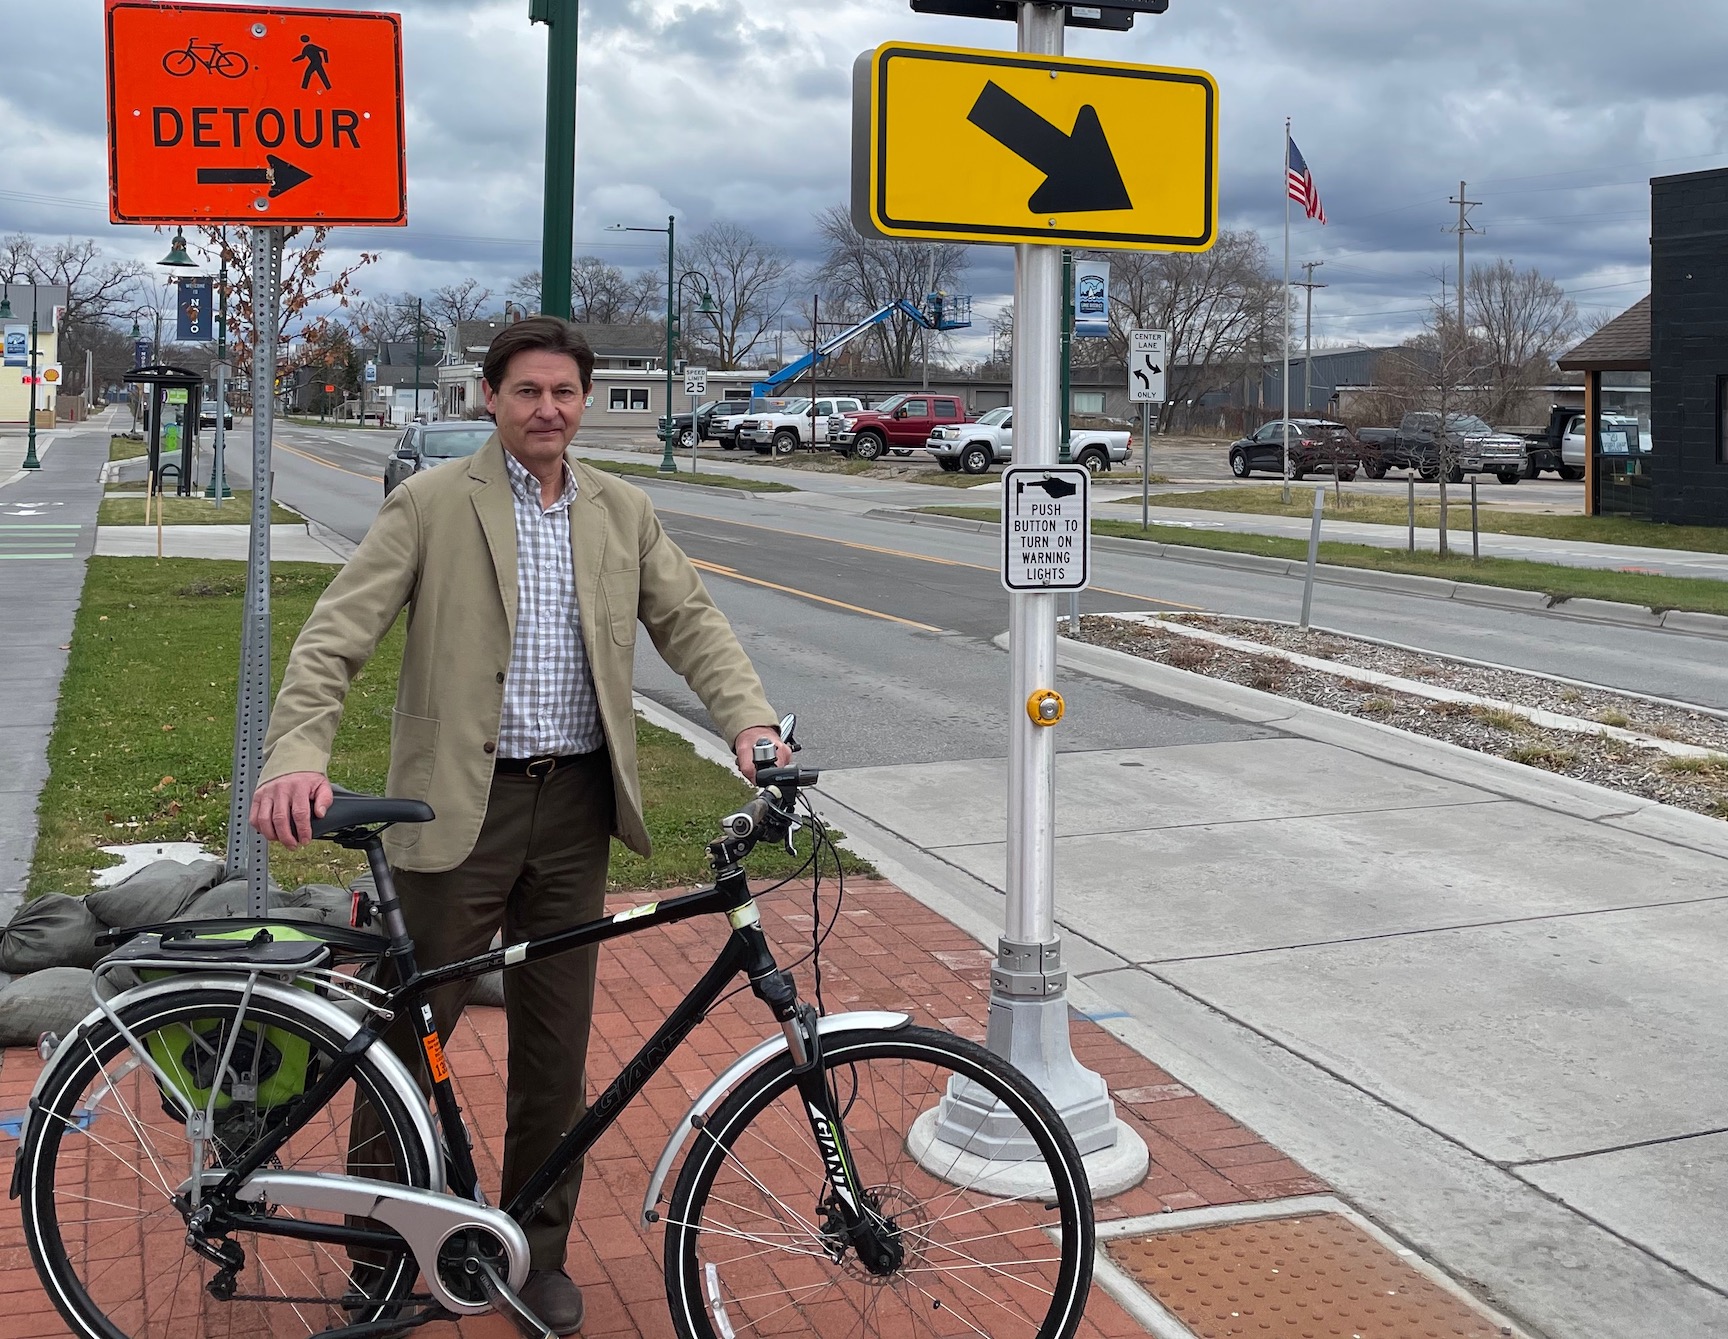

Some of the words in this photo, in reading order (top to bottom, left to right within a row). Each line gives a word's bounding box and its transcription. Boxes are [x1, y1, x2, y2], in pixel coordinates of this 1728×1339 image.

[153, 106, 361, 149] DETOUR
[1134, 333, 1162, 341] CENTER
[686, 381, 705, 393] 25
[1137, 391, 1157, 399] ONLY
[1031, 503, 1062, 516] PUSH
[1014, 519, 1057, 532] BUTTON
[1064, 519, 1079, 532] TO
[1020, 535, 1049, 548] TURN
[1057, 535, 1072, 548] ON
[1022, 551, 1071, 564] WARNING
[1027, 567, 1066, 580] LIGHTS
[593, 1019, 691, 1118] GIANT
[813, 1117, 851, 1194] GIANT
